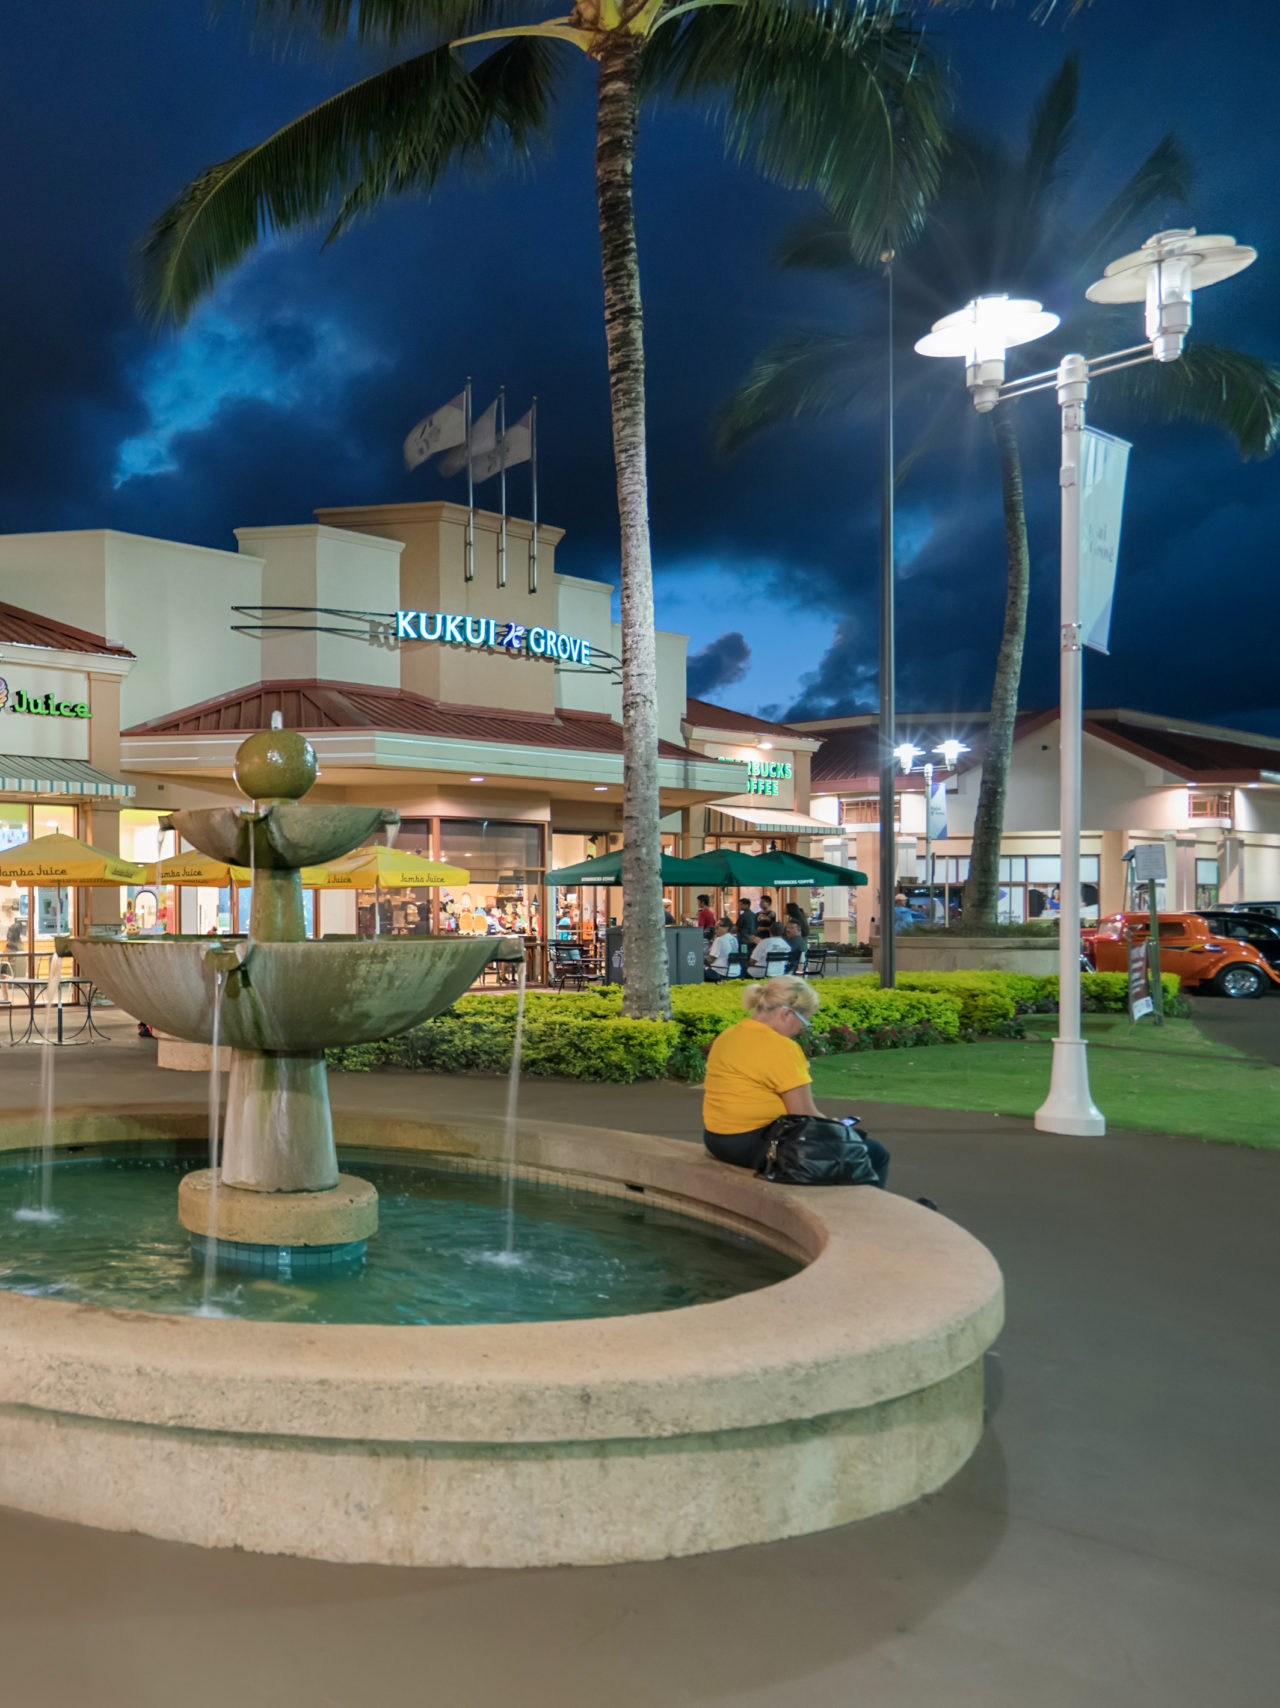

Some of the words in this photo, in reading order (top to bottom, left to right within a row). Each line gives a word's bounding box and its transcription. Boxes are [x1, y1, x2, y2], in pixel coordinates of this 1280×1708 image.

[396, 609, 497, 646] KUKUI
[528, 626, 592, 665] GROVE
[14, 690, 93, 718] Juice
[746, 778, 779, 796] FFEE
[37, 865, 68, 876] Juice
[160, 869, 181, 878] amba
[181, 866, 203, 876] Juice
[400, 873, 425, 883] Jamba
[425, 873, 446, 883] Juice
